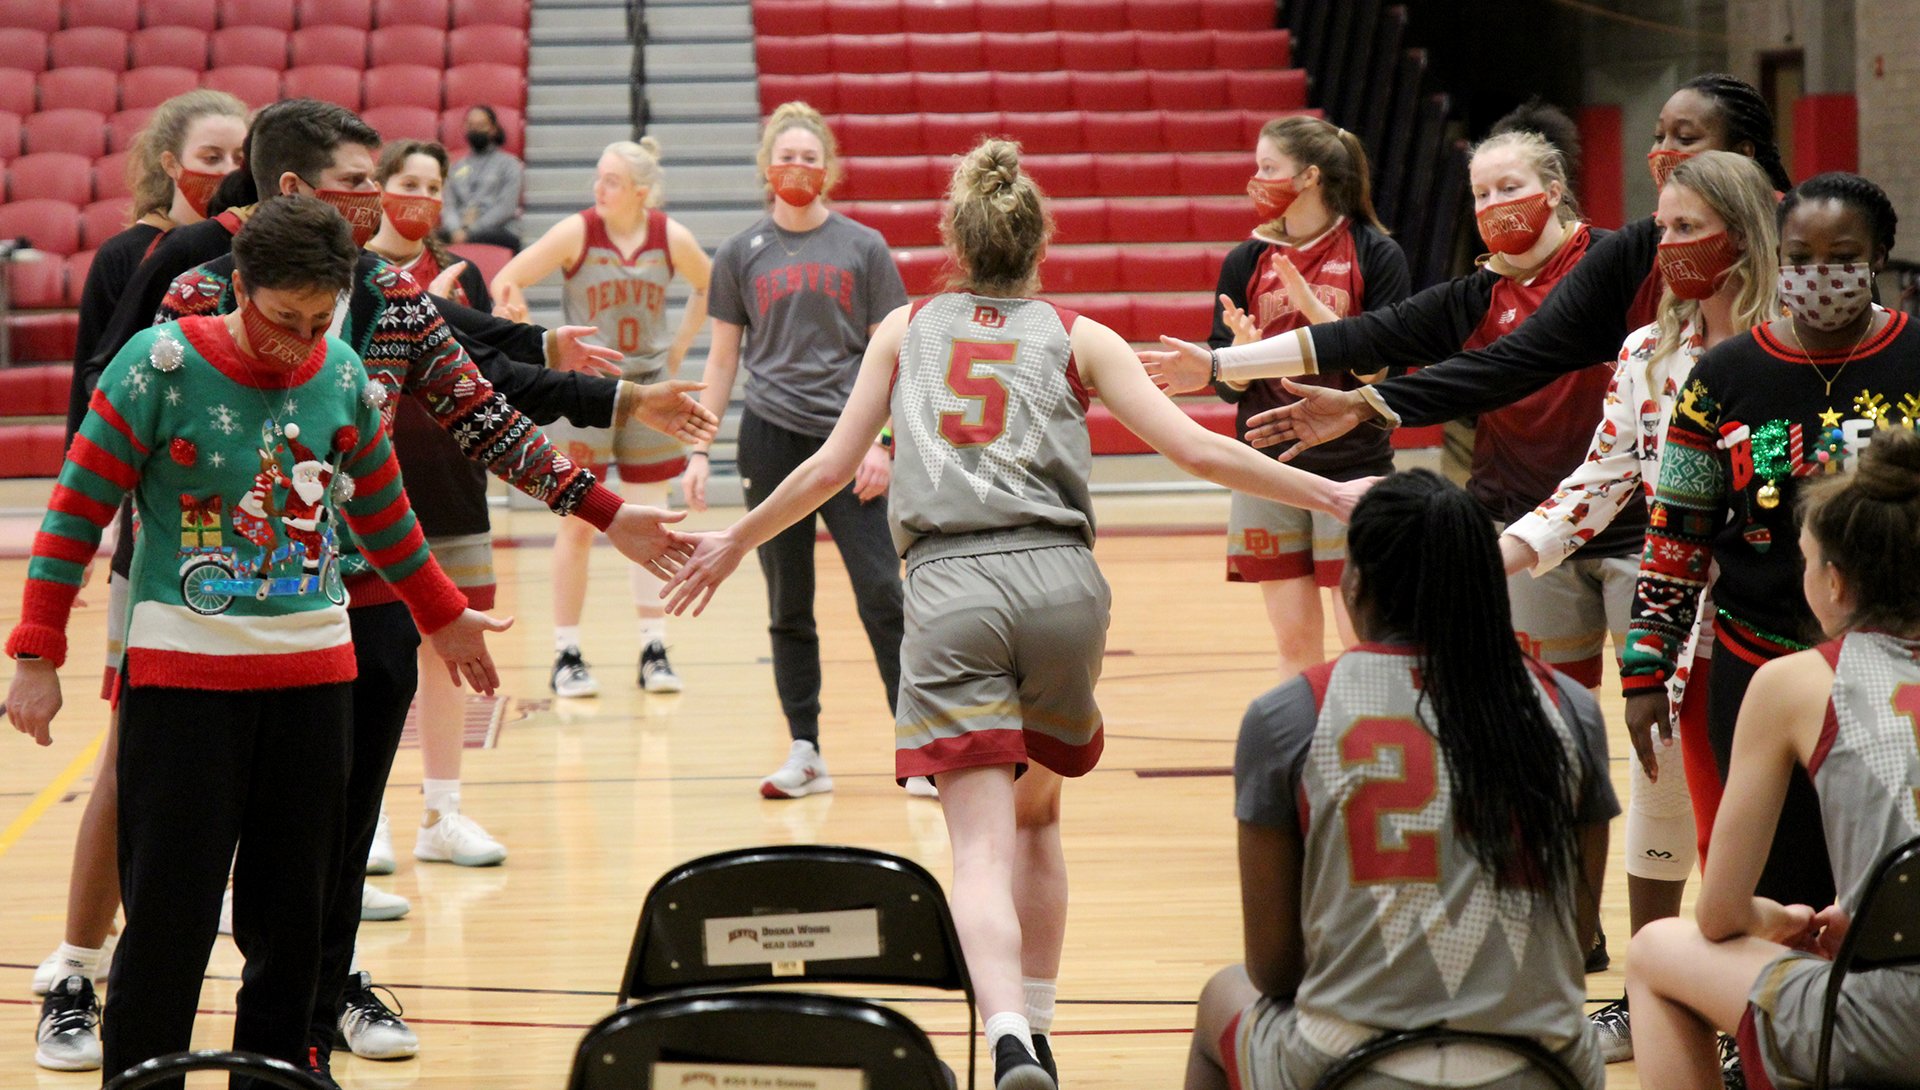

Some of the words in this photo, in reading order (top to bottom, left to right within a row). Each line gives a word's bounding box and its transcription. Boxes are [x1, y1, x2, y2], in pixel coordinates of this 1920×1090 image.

[754, 262, 854, 317] DENVER
[617, 317, 640, 352] 0
[971, 306, 1007, 328] DU
[938, 337, 1020, 449] 5
[1243, 527, 1280, 559] DU
